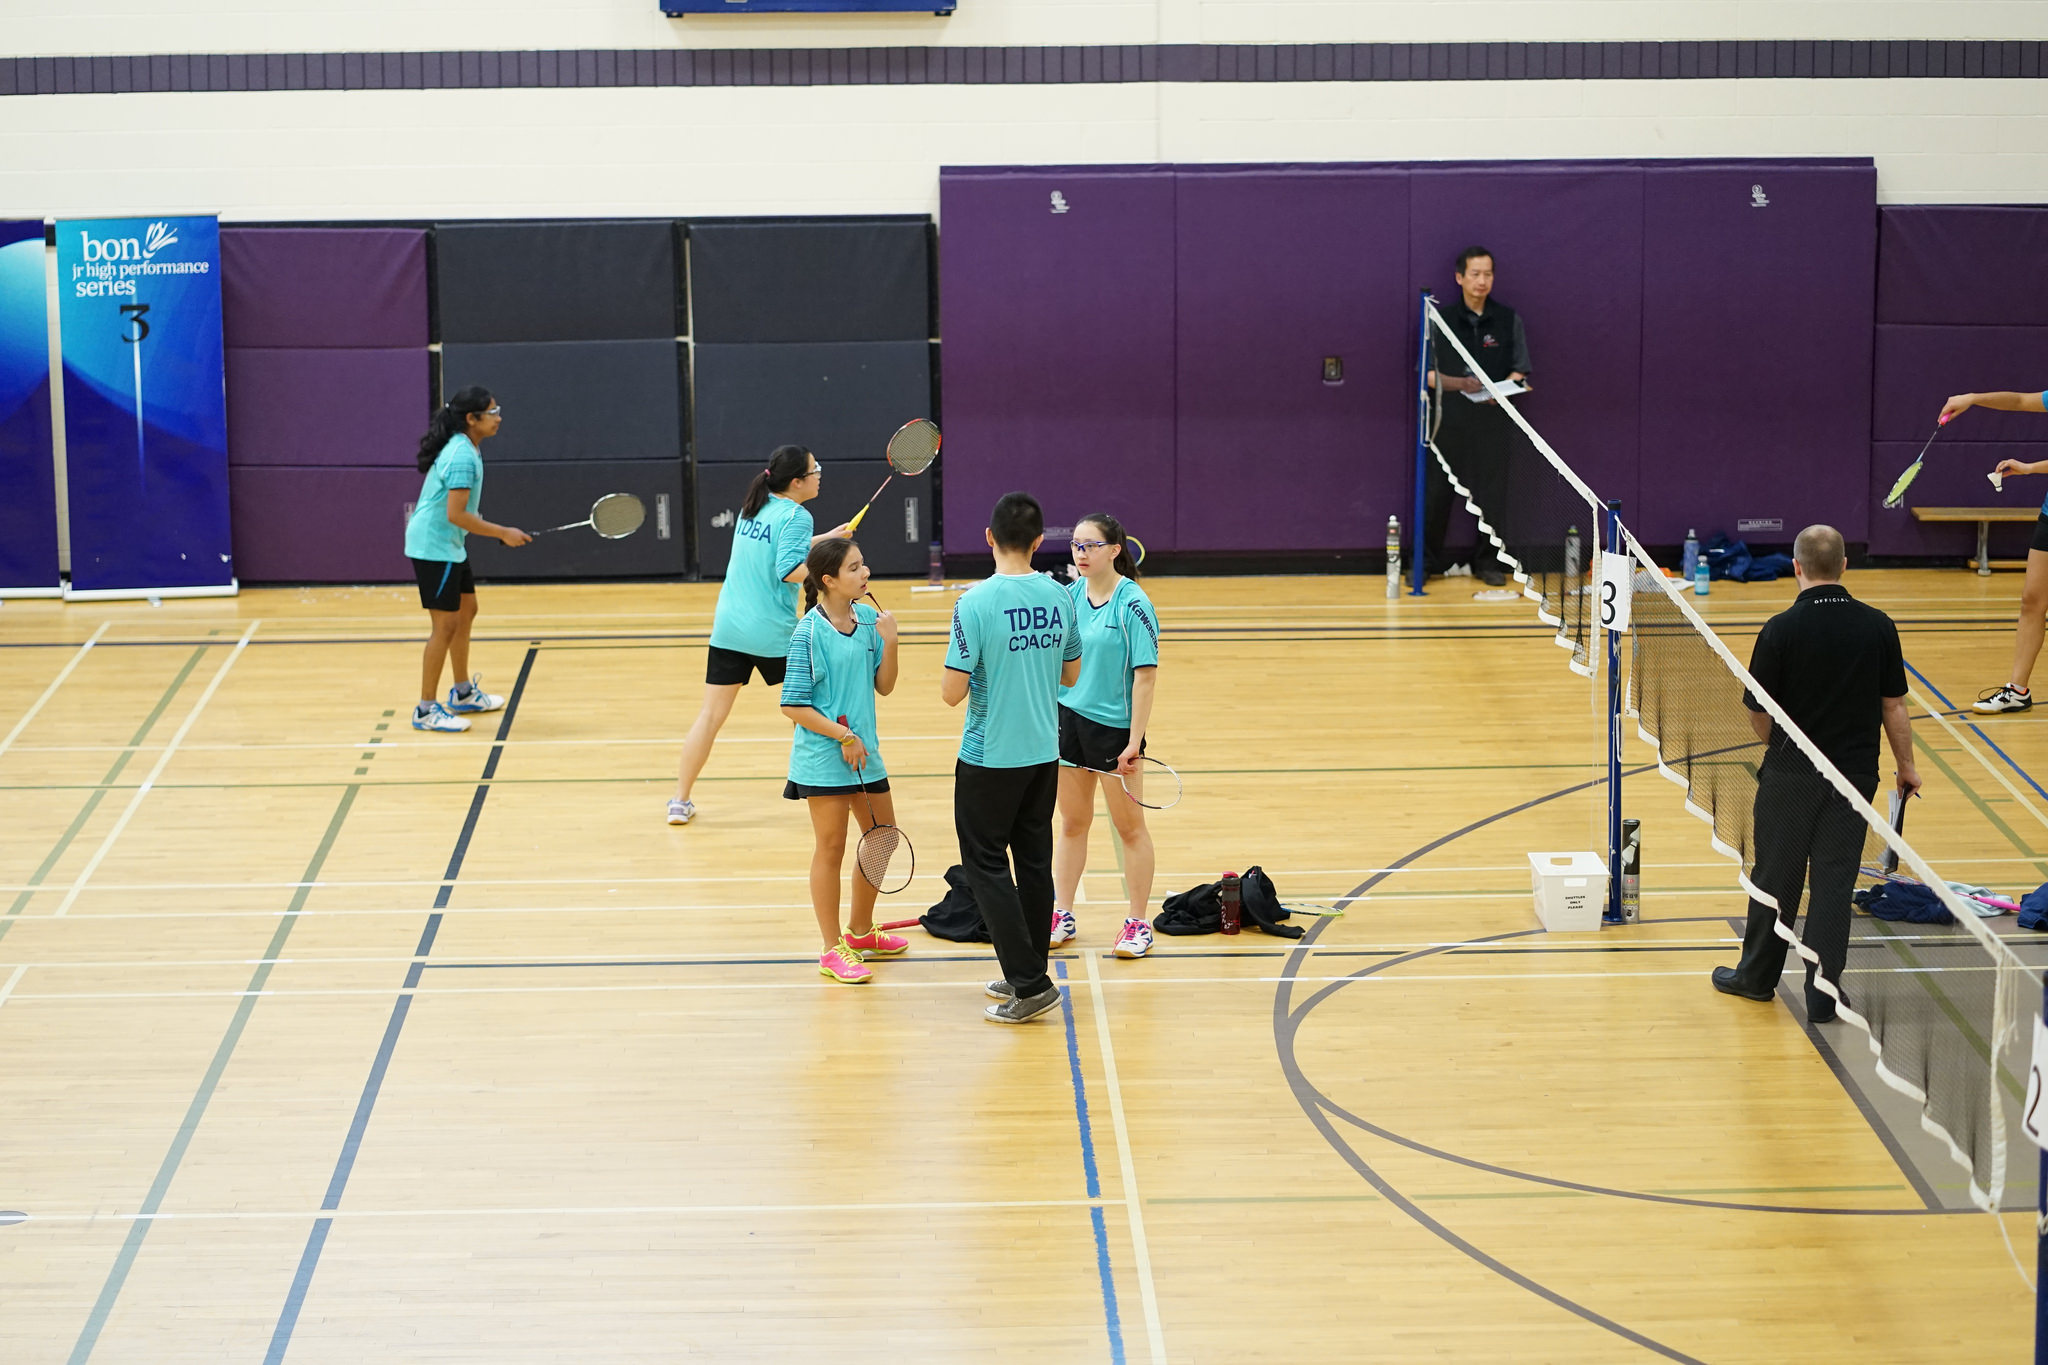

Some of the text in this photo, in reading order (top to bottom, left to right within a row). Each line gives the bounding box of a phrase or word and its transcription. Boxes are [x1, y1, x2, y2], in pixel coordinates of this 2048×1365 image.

[80, 230, 142, 262] bon
[72, 260, 210, 281] jr high performance
[76, 276, 136, 298] series
[119, 304, 151, 344] 3
[1601, 580, 1617, 625] 3
[1003, 606, 1063, 632] TDBA
[1008, 633, 1063, 652] COACH
